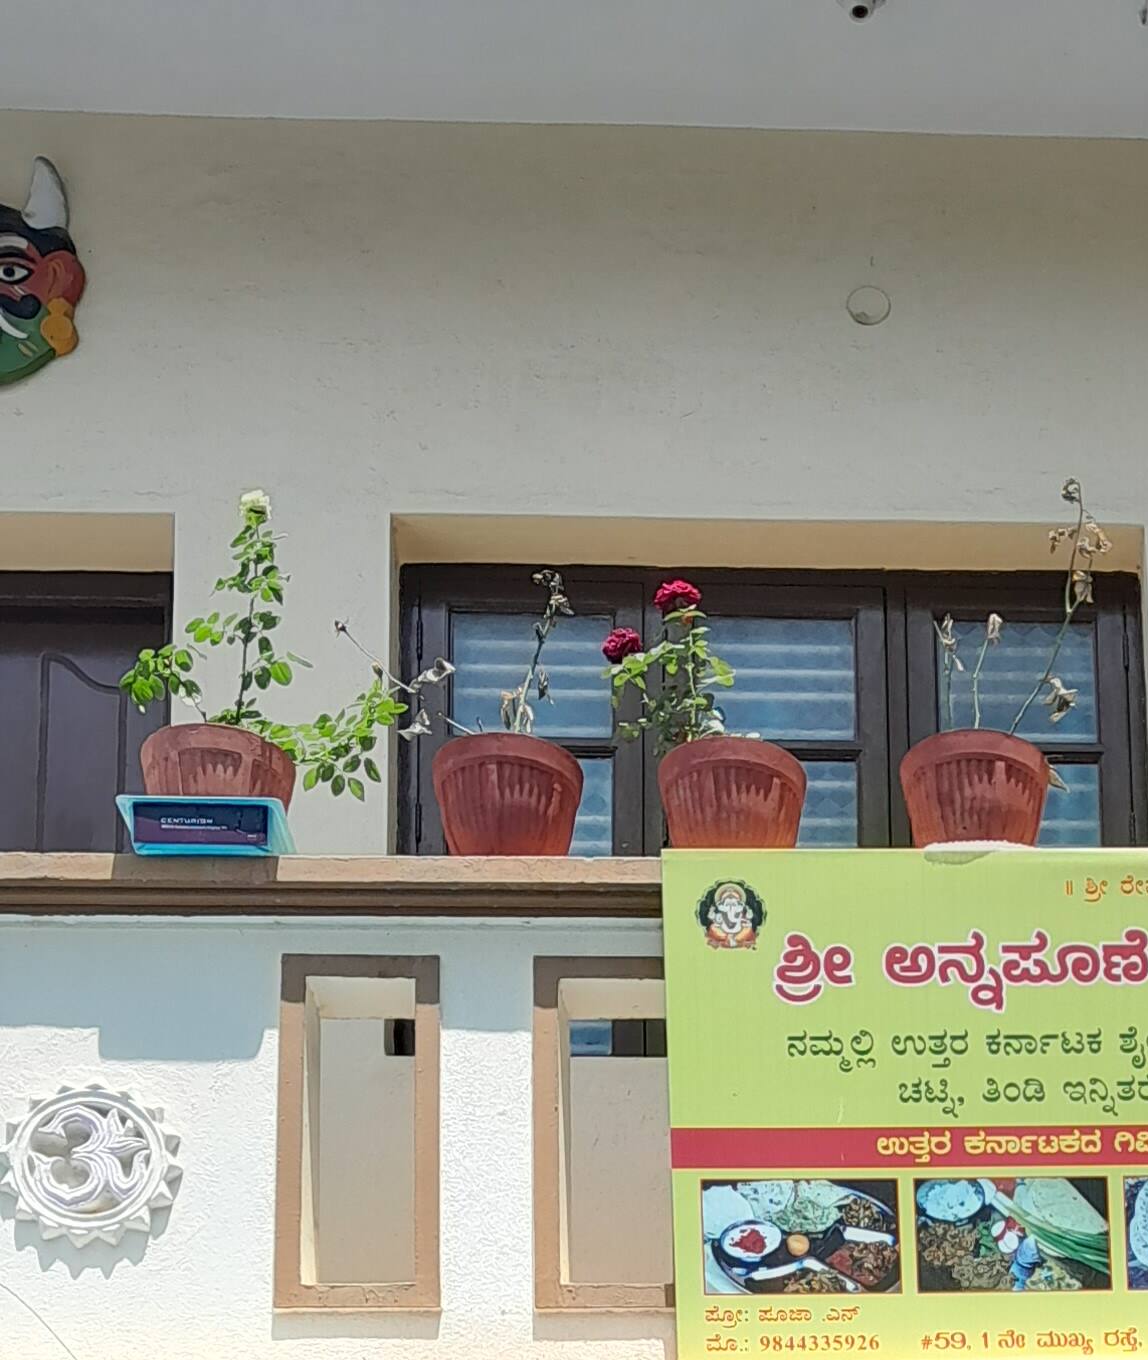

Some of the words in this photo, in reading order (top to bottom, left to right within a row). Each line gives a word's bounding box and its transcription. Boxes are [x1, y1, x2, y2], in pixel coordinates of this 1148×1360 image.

[1083, 877, 1108, 903] ಶ್ರೀ
[774, 933, 853, 1004] ಶ್ರೀ
[786, 1028, 877, 1073] ನಮ್ಮಲ್ಲಿ
[890, 1028, 969, 1069] ಉತ್ತರ
[985, 1027, 1103, 1057] ಕರ್ನಾಟಕ
[898, 1076, 965, 1118] ಚಟ್ನಿ,
[981, 1076, 1046, 1103] ತಿಂಡಿ
[876, 1130, 952, 1163] ಉತ್ತರ
[963, 1128, 1102, 1155] ಕರ್ನಾಟಕದ
[758, 1305, 813, 1323] ಪೂಜಾ
[759, 1334, 880, 1352] 9844335926
[919, 1331, 972, 1351] #59,
[980, 1331, 990, 1350] 1
[997, 1329, 1027, 1350] ನೇ
[1035, 1330, 1095, 1356] ಮುಖ್ಯ
[1102, 1327, 1143, 1352] ರಸ್ತೆ,
